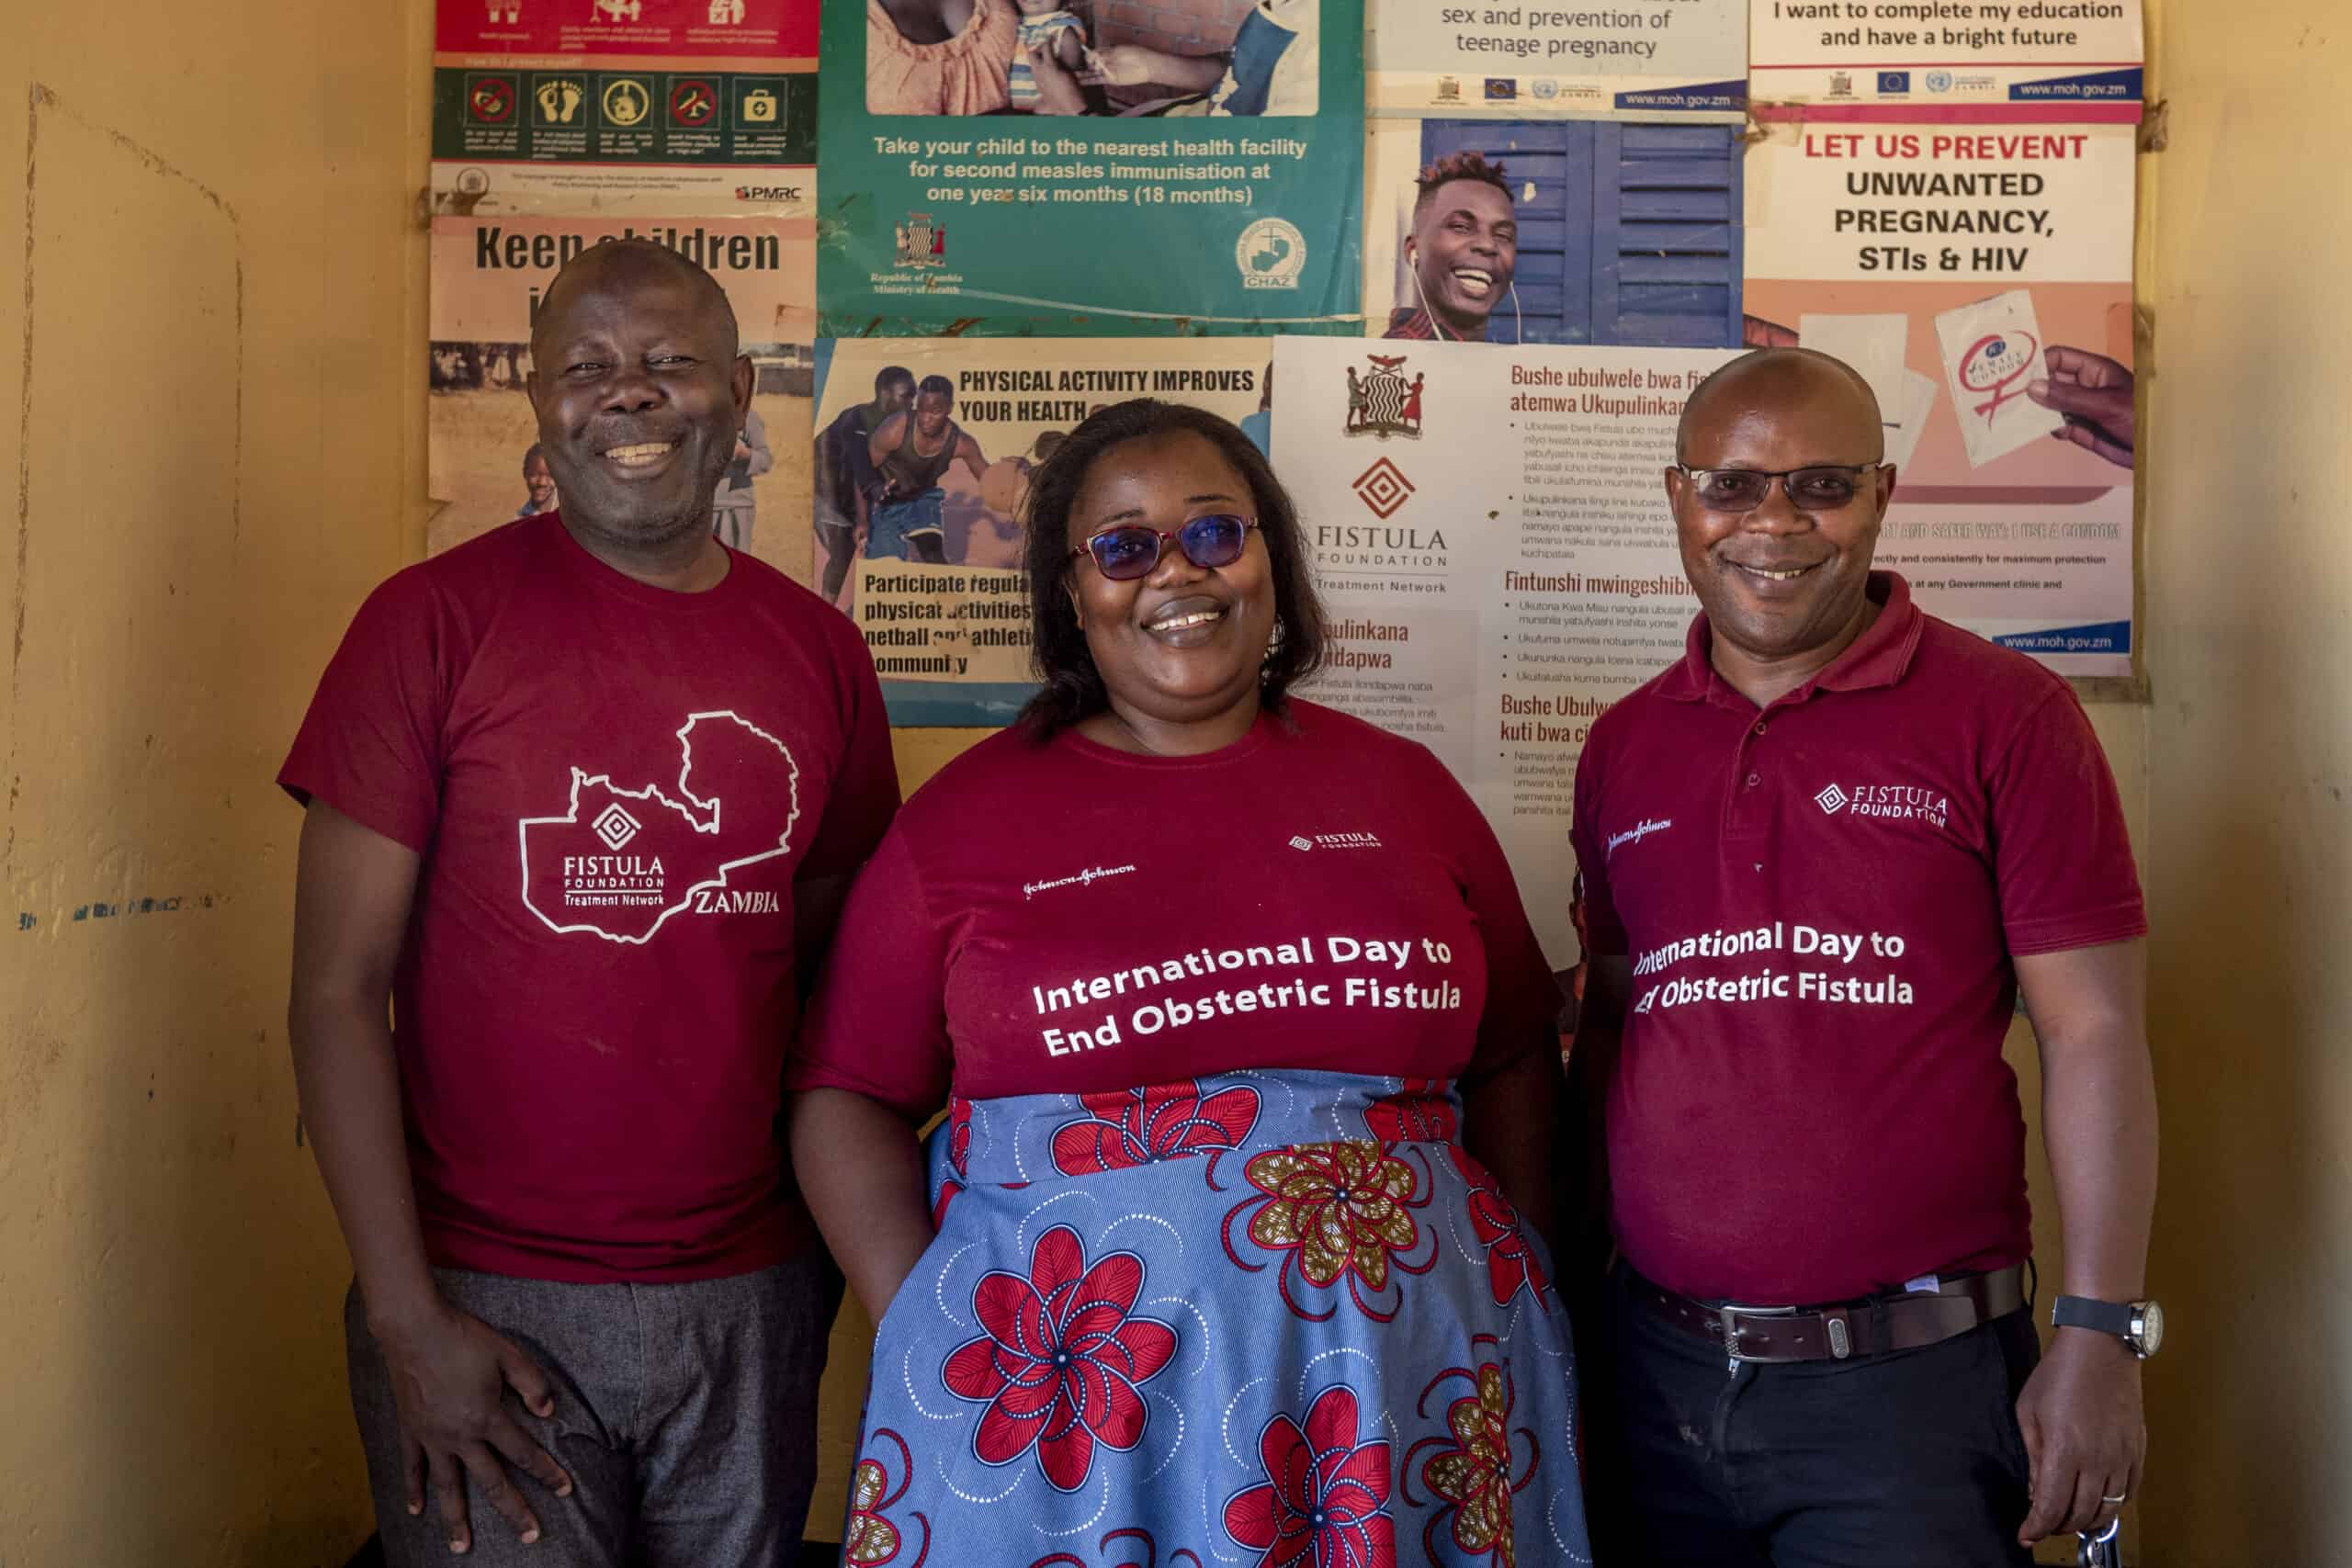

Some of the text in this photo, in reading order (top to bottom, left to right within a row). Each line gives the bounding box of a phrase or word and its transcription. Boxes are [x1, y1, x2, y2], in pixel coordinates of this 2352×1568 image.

[1442, 7, 1673, 31] sex and prevention of
[1774, 0, 2123, 23] I want to complete my education
[1456, 34, 1657, 59] teenage pregnancy
[1821, 26, 2078, 50] and have a bright future
[1625, 94, 1731, 107] www.moh.gov.zm
[2020, 84, 2127, 98] www.moh.gov.zm
[874, 137, 1307, 159] Take your child to the nearest health facility
[1804, 134, 2089, 159] LET US PREVENT
[909, 161, 1272, 180] for second measles immunisation at
[752, 186, 802, 200] PMRC
[926, 185, 1253, 206] one year six months (18 months)
[1846, 172, 2045, 197] UNWANTED
[1834, 209, 2054, 238] PREGNANCY,
[476, 227, 584, 269] Keep
[1858, 246, 2030, 272] STIs & HIV
[1247, 277, 1288, 287] CHAZ
[959, 369, 1255, 392] PHYSICAL ACTIVITY IMPROVES
[1510, 365, 1563, 387] Bushe
[1567, 367, 1643, 389] ubulwele
[1646, 369, 1681, 389] bwa
[959, 401, 1088, 422] YOUR HEALTH
[1510, 392, 1577, 412] atemwa
[1317, 525, 1448, 551] FISTULA
[1317, 552, 1448, 568] FOUNDATION
[1900, 554, 1919, 564] and
[1922, 554, 1984, 566] consistently
[1986, 554, 2001, 564] for
[2003, 554, 2052, 564] maximum
[2054, 555, 2107, 566] protection
[865, 574, 966, 594] Participate
[1316, 579, 1447, 594] Treatment Network
[1505, 570, 1582, 593] Fintunshi
[1927, 581, 1946, 591] any
[1948, 579, 2010, 589] Government
[2012, 579, 2041, 589] clinic
[2042, 579, 2063, 589] and
[865, 602, 1032, 622] physical ctivities
[865, 627, 930, 647] netball
[2004, 636, 2112, 651] www.moh.gov.zm
[874, 655, 968, 674] ommuniy
[1501, 694, 1551, 716] Bushe
[1500, 720, 1532, 742] kuti
[1537, 722, 1571, 742] bwa
[1853, 786, 1949, 816] FISTULA
[1850, 803, 1946, 829] FOUNDATION
[1316, 832, 1378, 844] FISTULA
[1321, 840, 1382, 849] FOUNDATION
[564, 856, 664, 875] FISTULA
[564, 878, 664, 888] FOUNDATION
[565, 895, 664, 906] Treatment Network
[695, 891, 780, 914] ZAMBIA
[1634, 921, 1905, 976] International Day to
[1033, 936, 1452, 1014] International Day to
[1661, 969, 1790, 1008] Obstetric
[1798, 974, 1913, 1006] Fistula
[1042, 977, 1462, 1057] End Obstetric Fistula
